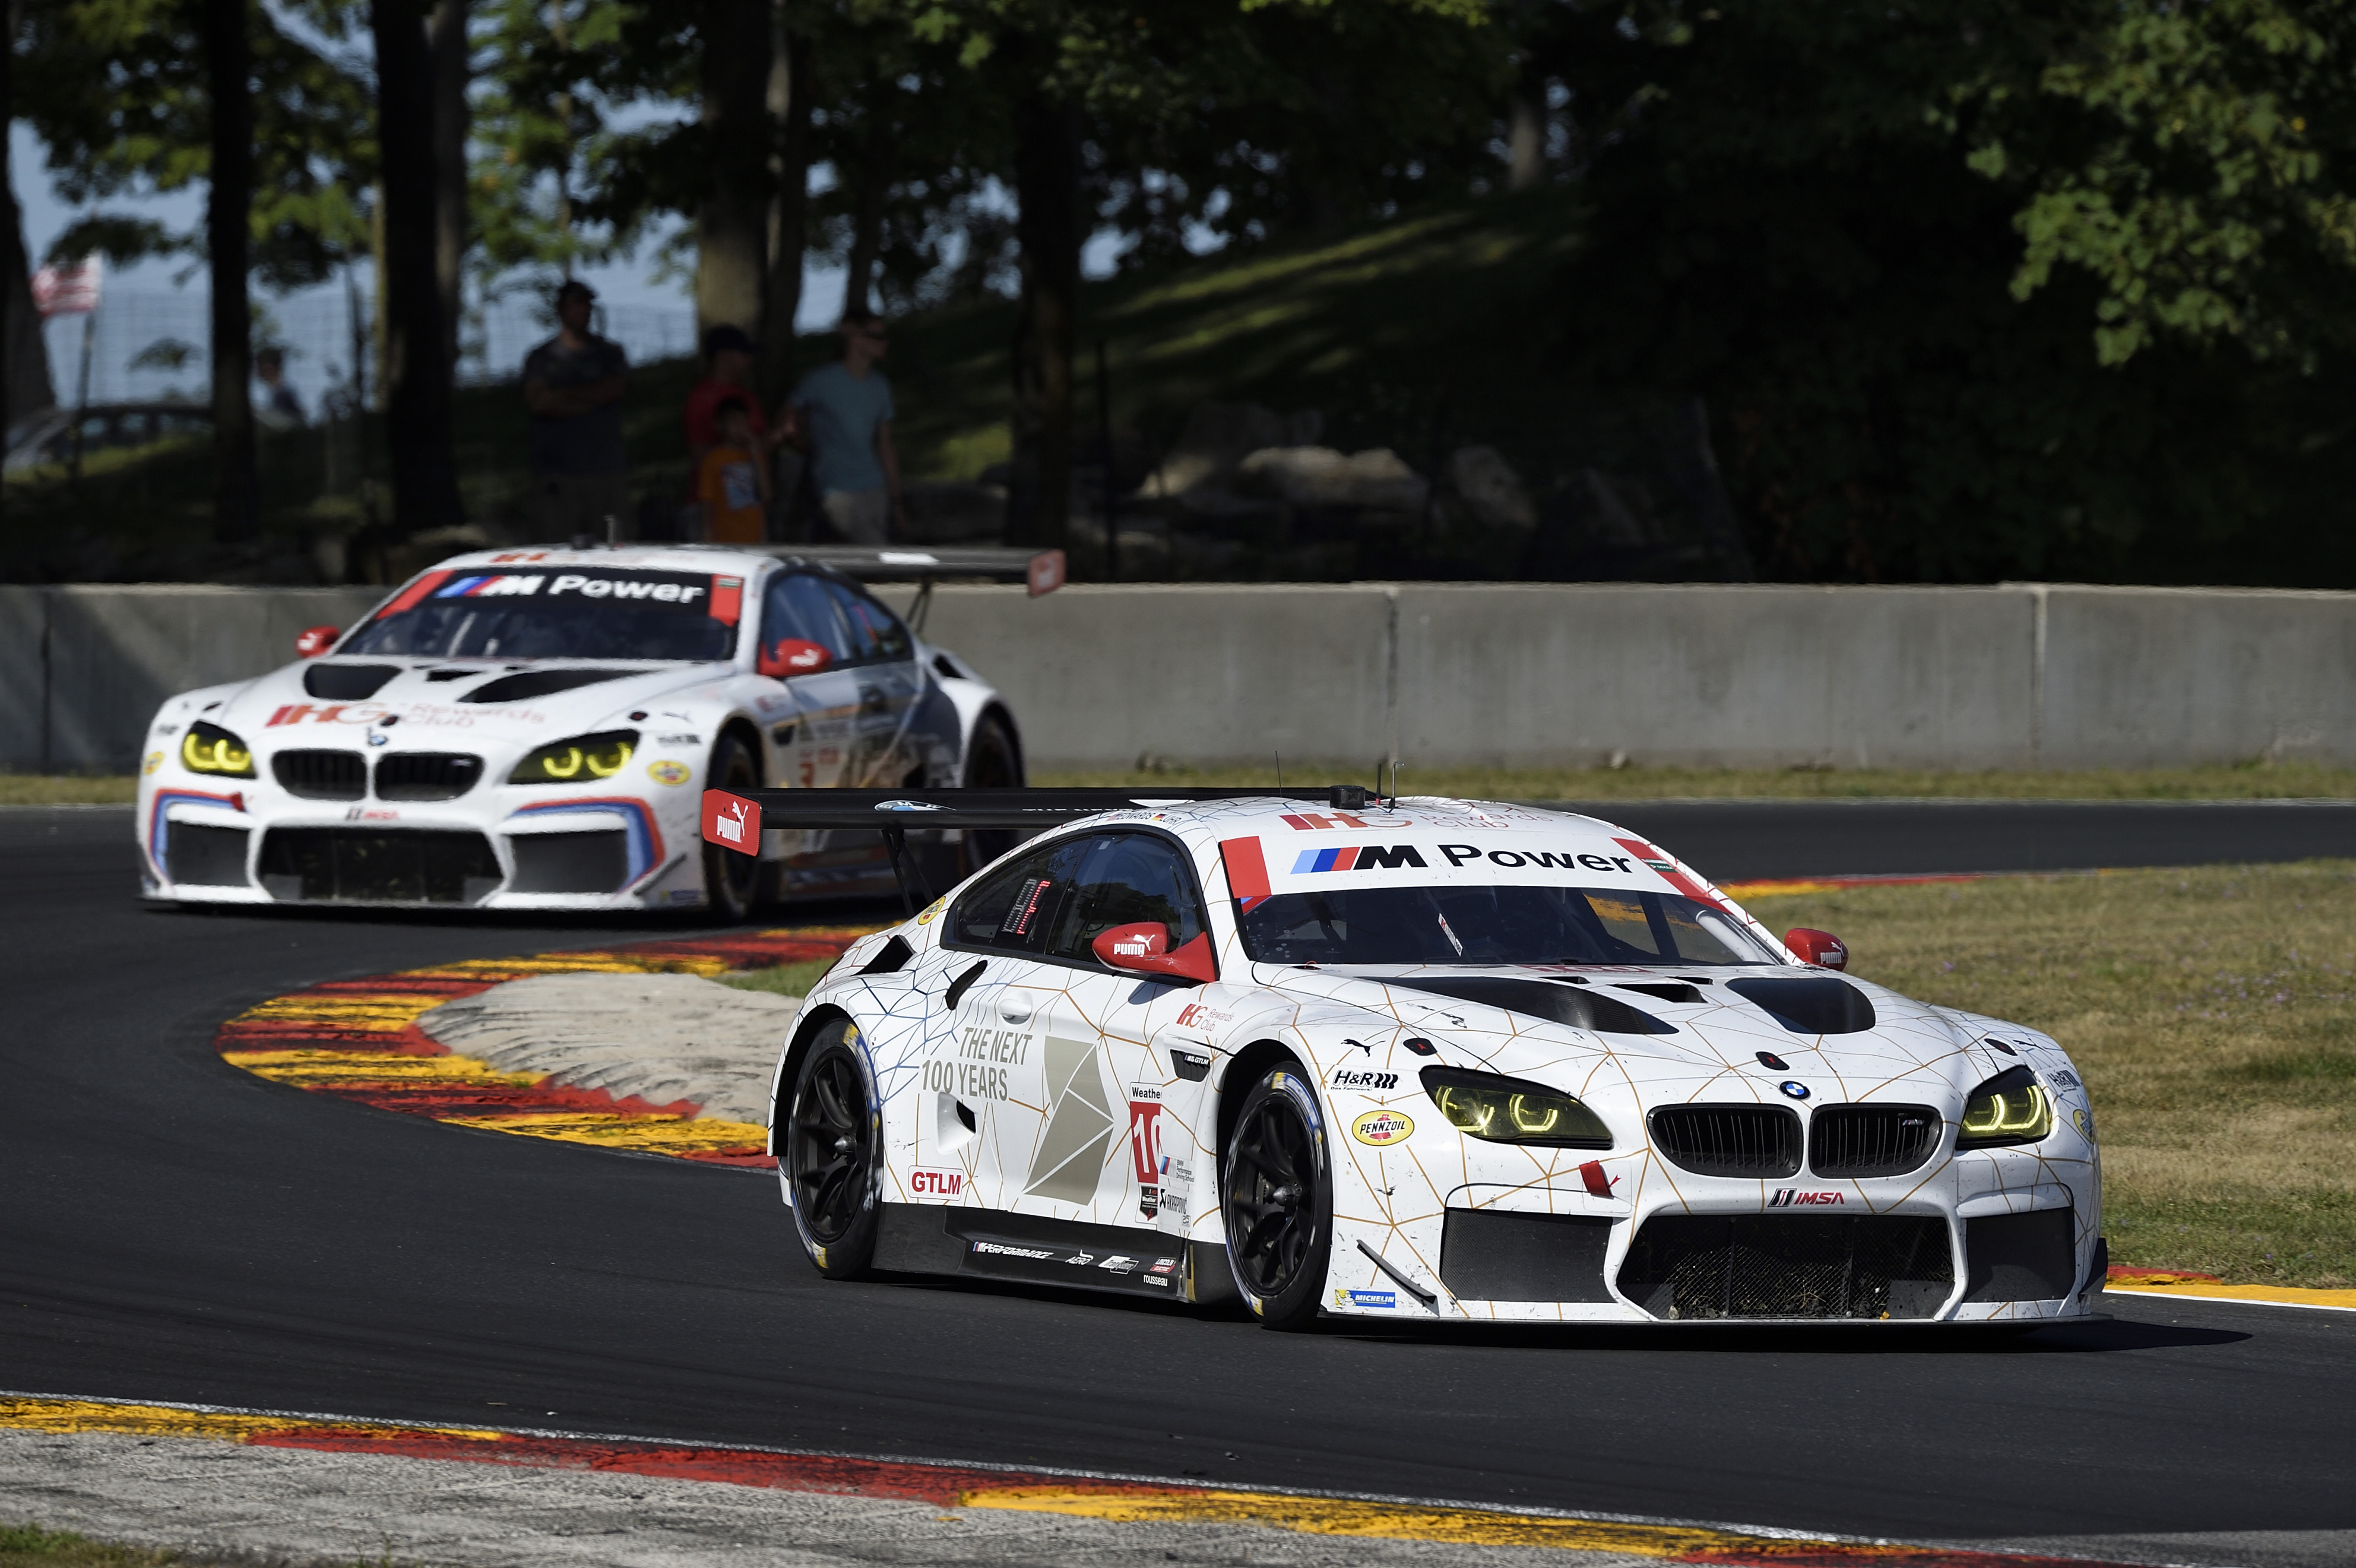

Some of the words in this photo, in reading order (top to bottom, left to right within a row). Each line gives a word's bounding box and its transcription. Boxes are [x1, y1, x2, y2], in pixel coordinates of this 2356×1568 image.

[547, 574, 705, 604] Power
[265, 702, 391, 728] IHG
[1116, 812, 1156, 821] EDWARDS
[1278, 812, 1413, 831] IHG
[1418, 812, 1554, 823] Rewards
[717, 814, 741, 844] PUMA
[1432, 820, 1510, 829] Club
[1352, 845, 1429, 870] M
[1437, 844, 1634, 873] Power
[1114, 943, 1145, 955] PUMA
[1819, 952, 1842, 965] PUMA
[1176, 1003, 1208, 1028] IHG
[1206, 1008, 1234, 1022] Rewards
[1200, 1019, 1215, 1032] Club
[959, 1027, 993, 1060] THE
[989, 1030, 1033, 1066] NEXT
[1195, 1057, 1209, 1065] GTLM
[922, 1059, 954, 1094] 100
[958, 1063, 1008, 1102] YEARS
[1334, 1070, 1374, 1086] H&R
[1132, 1086, 1163, 1099] Weathe
[1360, 1120, 1405, 1135] PENNZOIL
[911, 1171, 961, 1195] GTLM
[1794, 1192, 1845, 1205] IMSA
[1065, 1256, 1091, 1266] AERO
[1143, 1274, 1168, 1287] rousseau
[1355, 1294, 1395, 1303] MICHELIN
